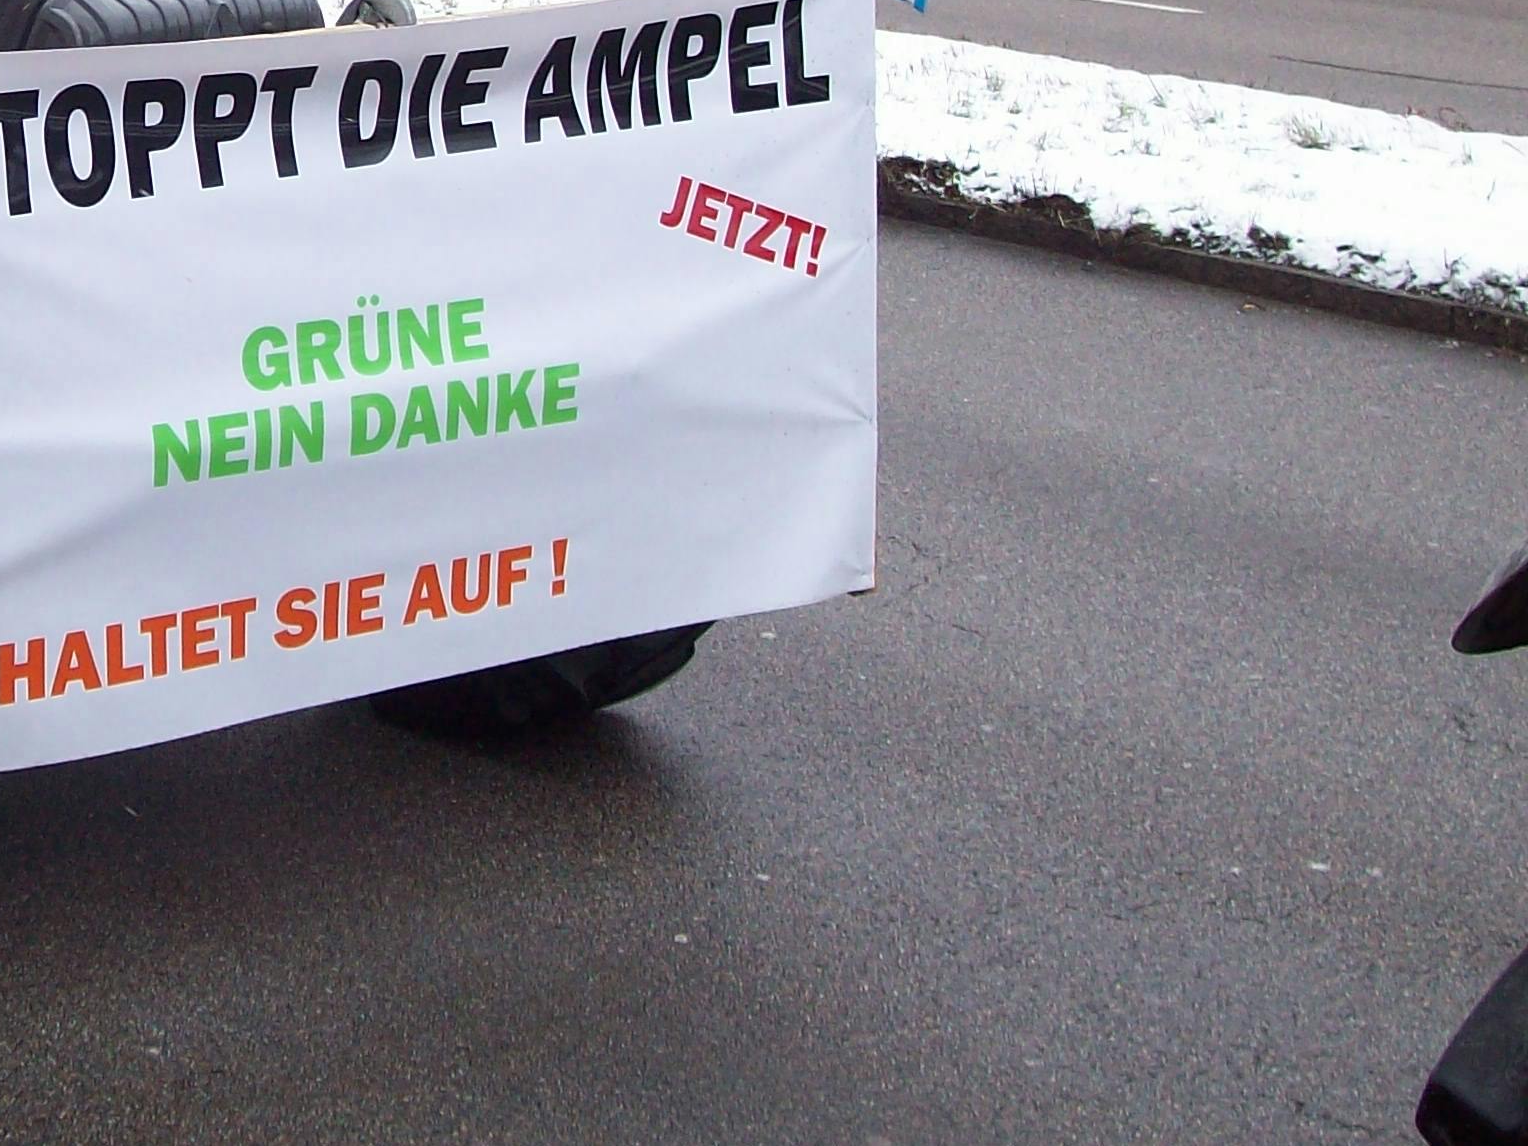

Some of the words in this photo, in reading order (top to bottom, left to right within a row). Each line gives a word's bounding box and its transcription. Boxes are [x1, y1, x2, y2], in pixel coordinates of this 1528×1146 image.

[338, 46, 508, 168] DIE
[660, 176, 827, 276] JETZT!
[241, 295, 490, 391] GRÜNE
[152, 401, 325, 487] NEIN
[351, 363, 580, 456] DANKE
[274, 573, 385, 649] SIE
[403, 545, 532, 625] AUF
[551, 539, 569, 595] !
